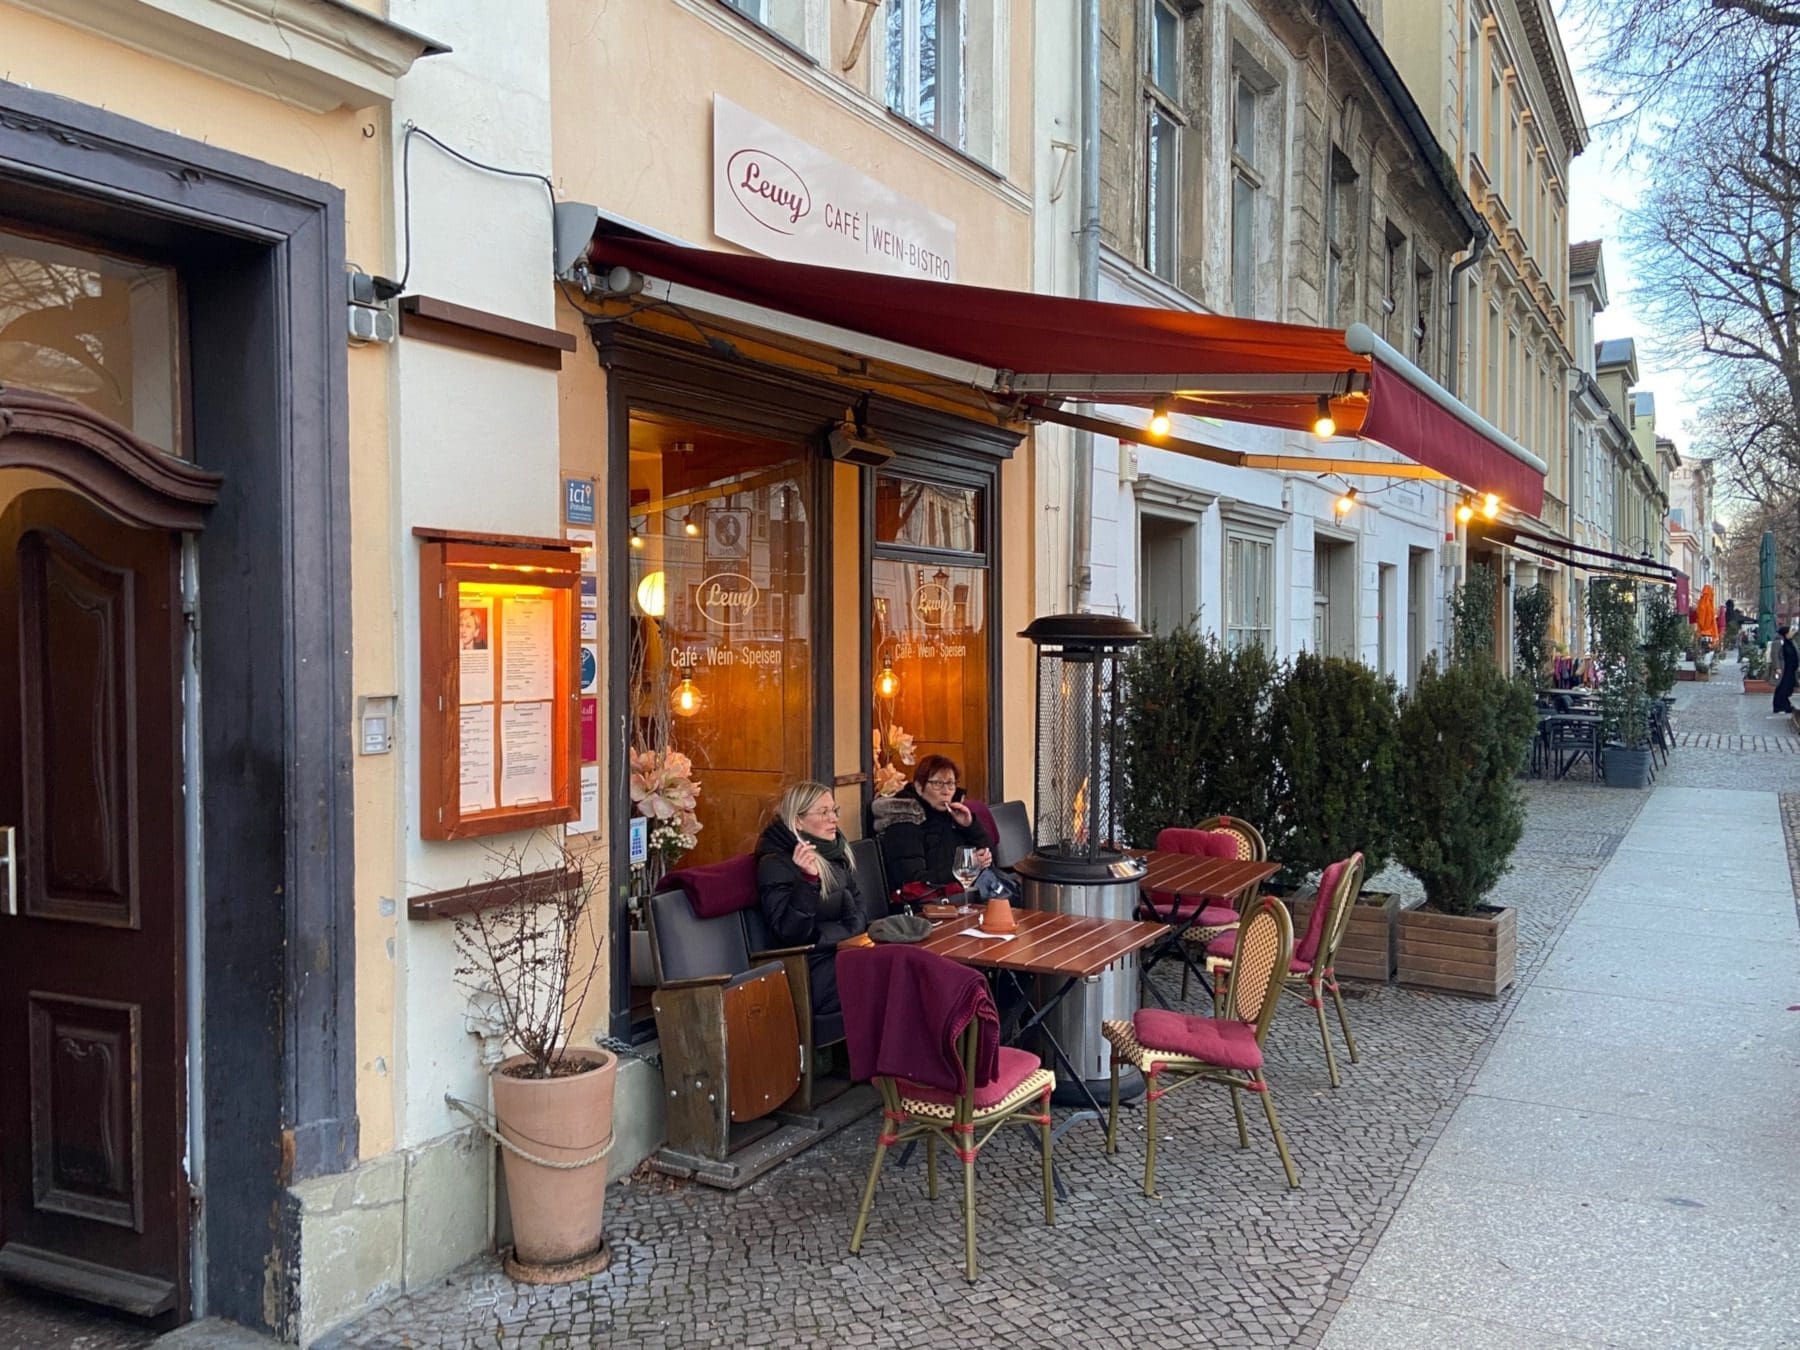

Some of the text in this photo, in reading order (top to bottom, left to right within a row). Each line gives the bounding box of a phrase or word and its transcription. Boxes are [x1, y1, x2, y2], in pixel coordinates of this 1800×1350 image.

[741, 162, 803, 224] Lewy
[825, 203, 950, 281] CAFÉ WEIN-BISTRO
[706, 583, 754, 616] Lewy
[671, 645, 782, 668] Café Wein Speisen
[895, 642, 966, 662] Café Wein Speisen
